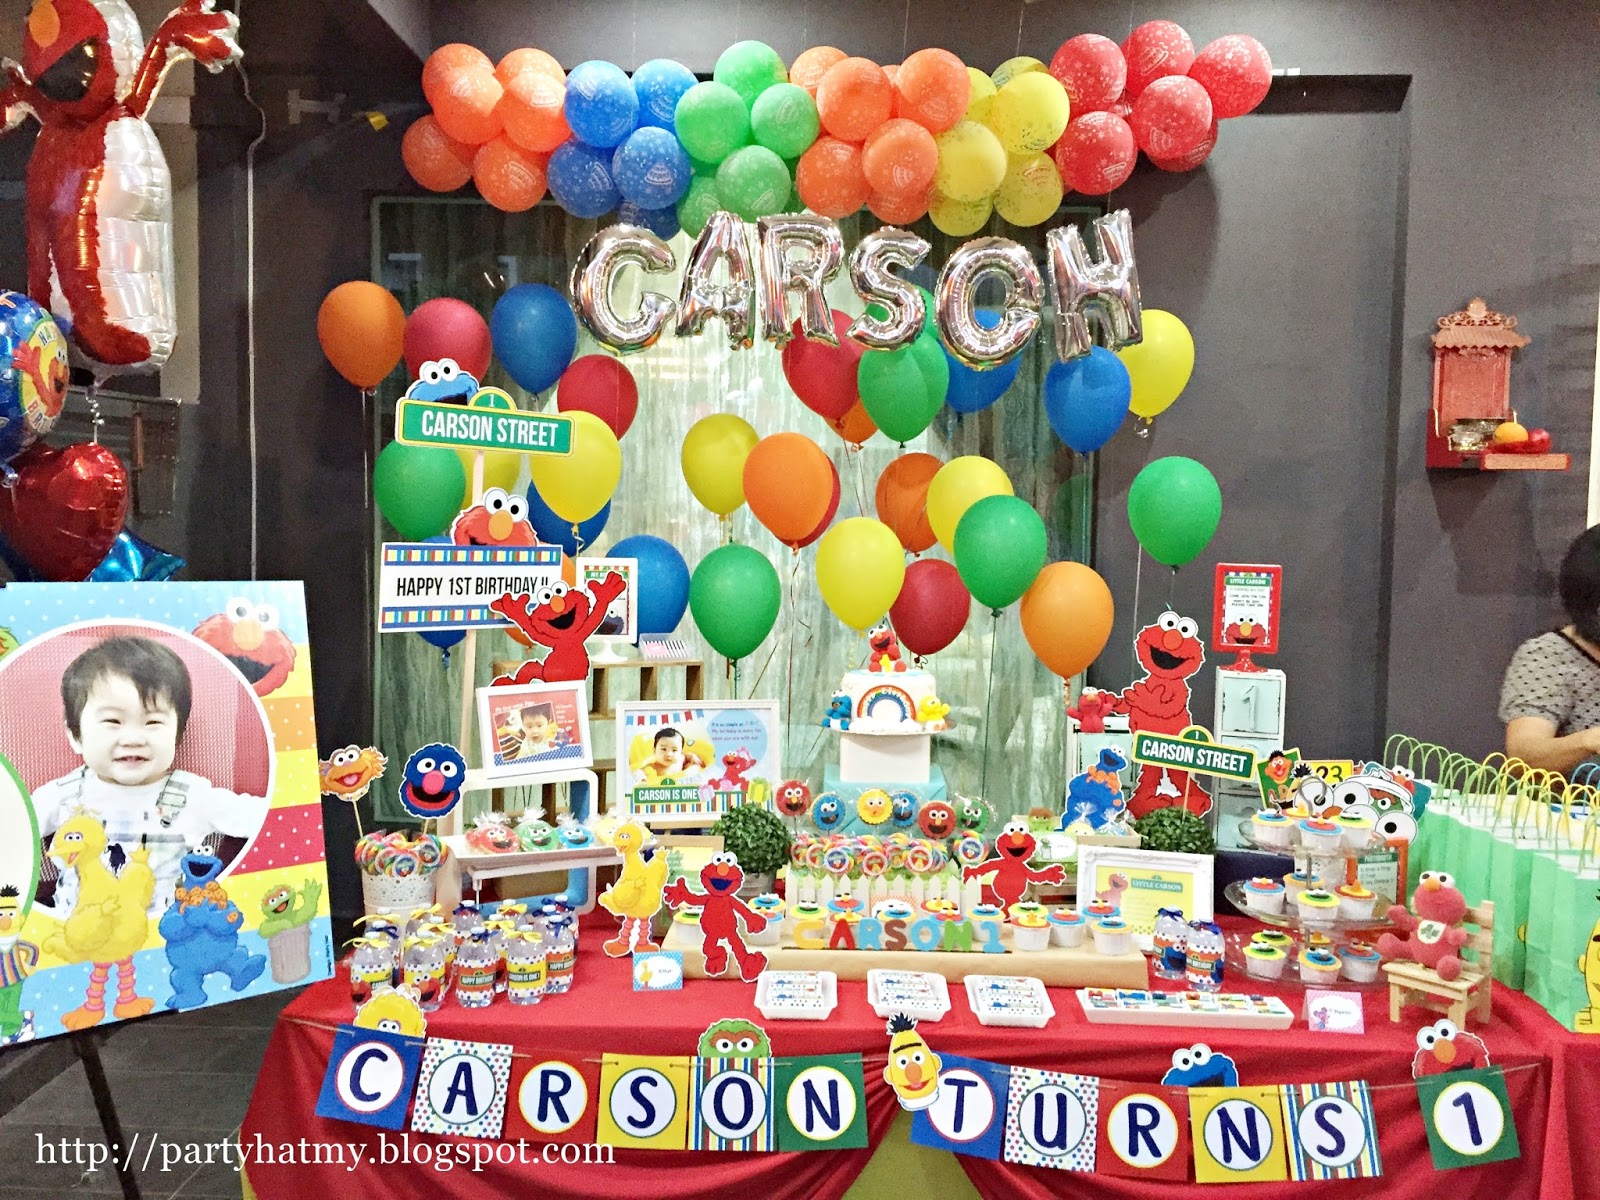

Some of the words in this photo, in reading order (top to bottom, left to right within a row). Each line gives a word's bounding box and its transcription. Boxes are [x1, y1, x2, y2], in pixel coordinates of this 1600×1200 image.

[488, 393, 496, 407] 1
[421, 410, 493, 441] CARSON
[496, 417, 559, 447] STREET
[396, 577, 443, 596] HAPPY
[448, 577, 472, 595] 1ST
[475, 576, 538, 595] BIRTHDAY
[1142, 739, 1195, 764] CARSON
[1196, 748, 1248, 773] STREET
[638, 789, 671, 801] CARSON
[672, 789, 679, 800] IS
[1132, 880, 1154, 888] LITTLE
[1154, 882, 1182, 890] CARSON
[348, 1047, 842, 1135] CARSON
[940, 1076, 1350, 1165] TURNS
[1453, 1095, 1485, 1147] 1
